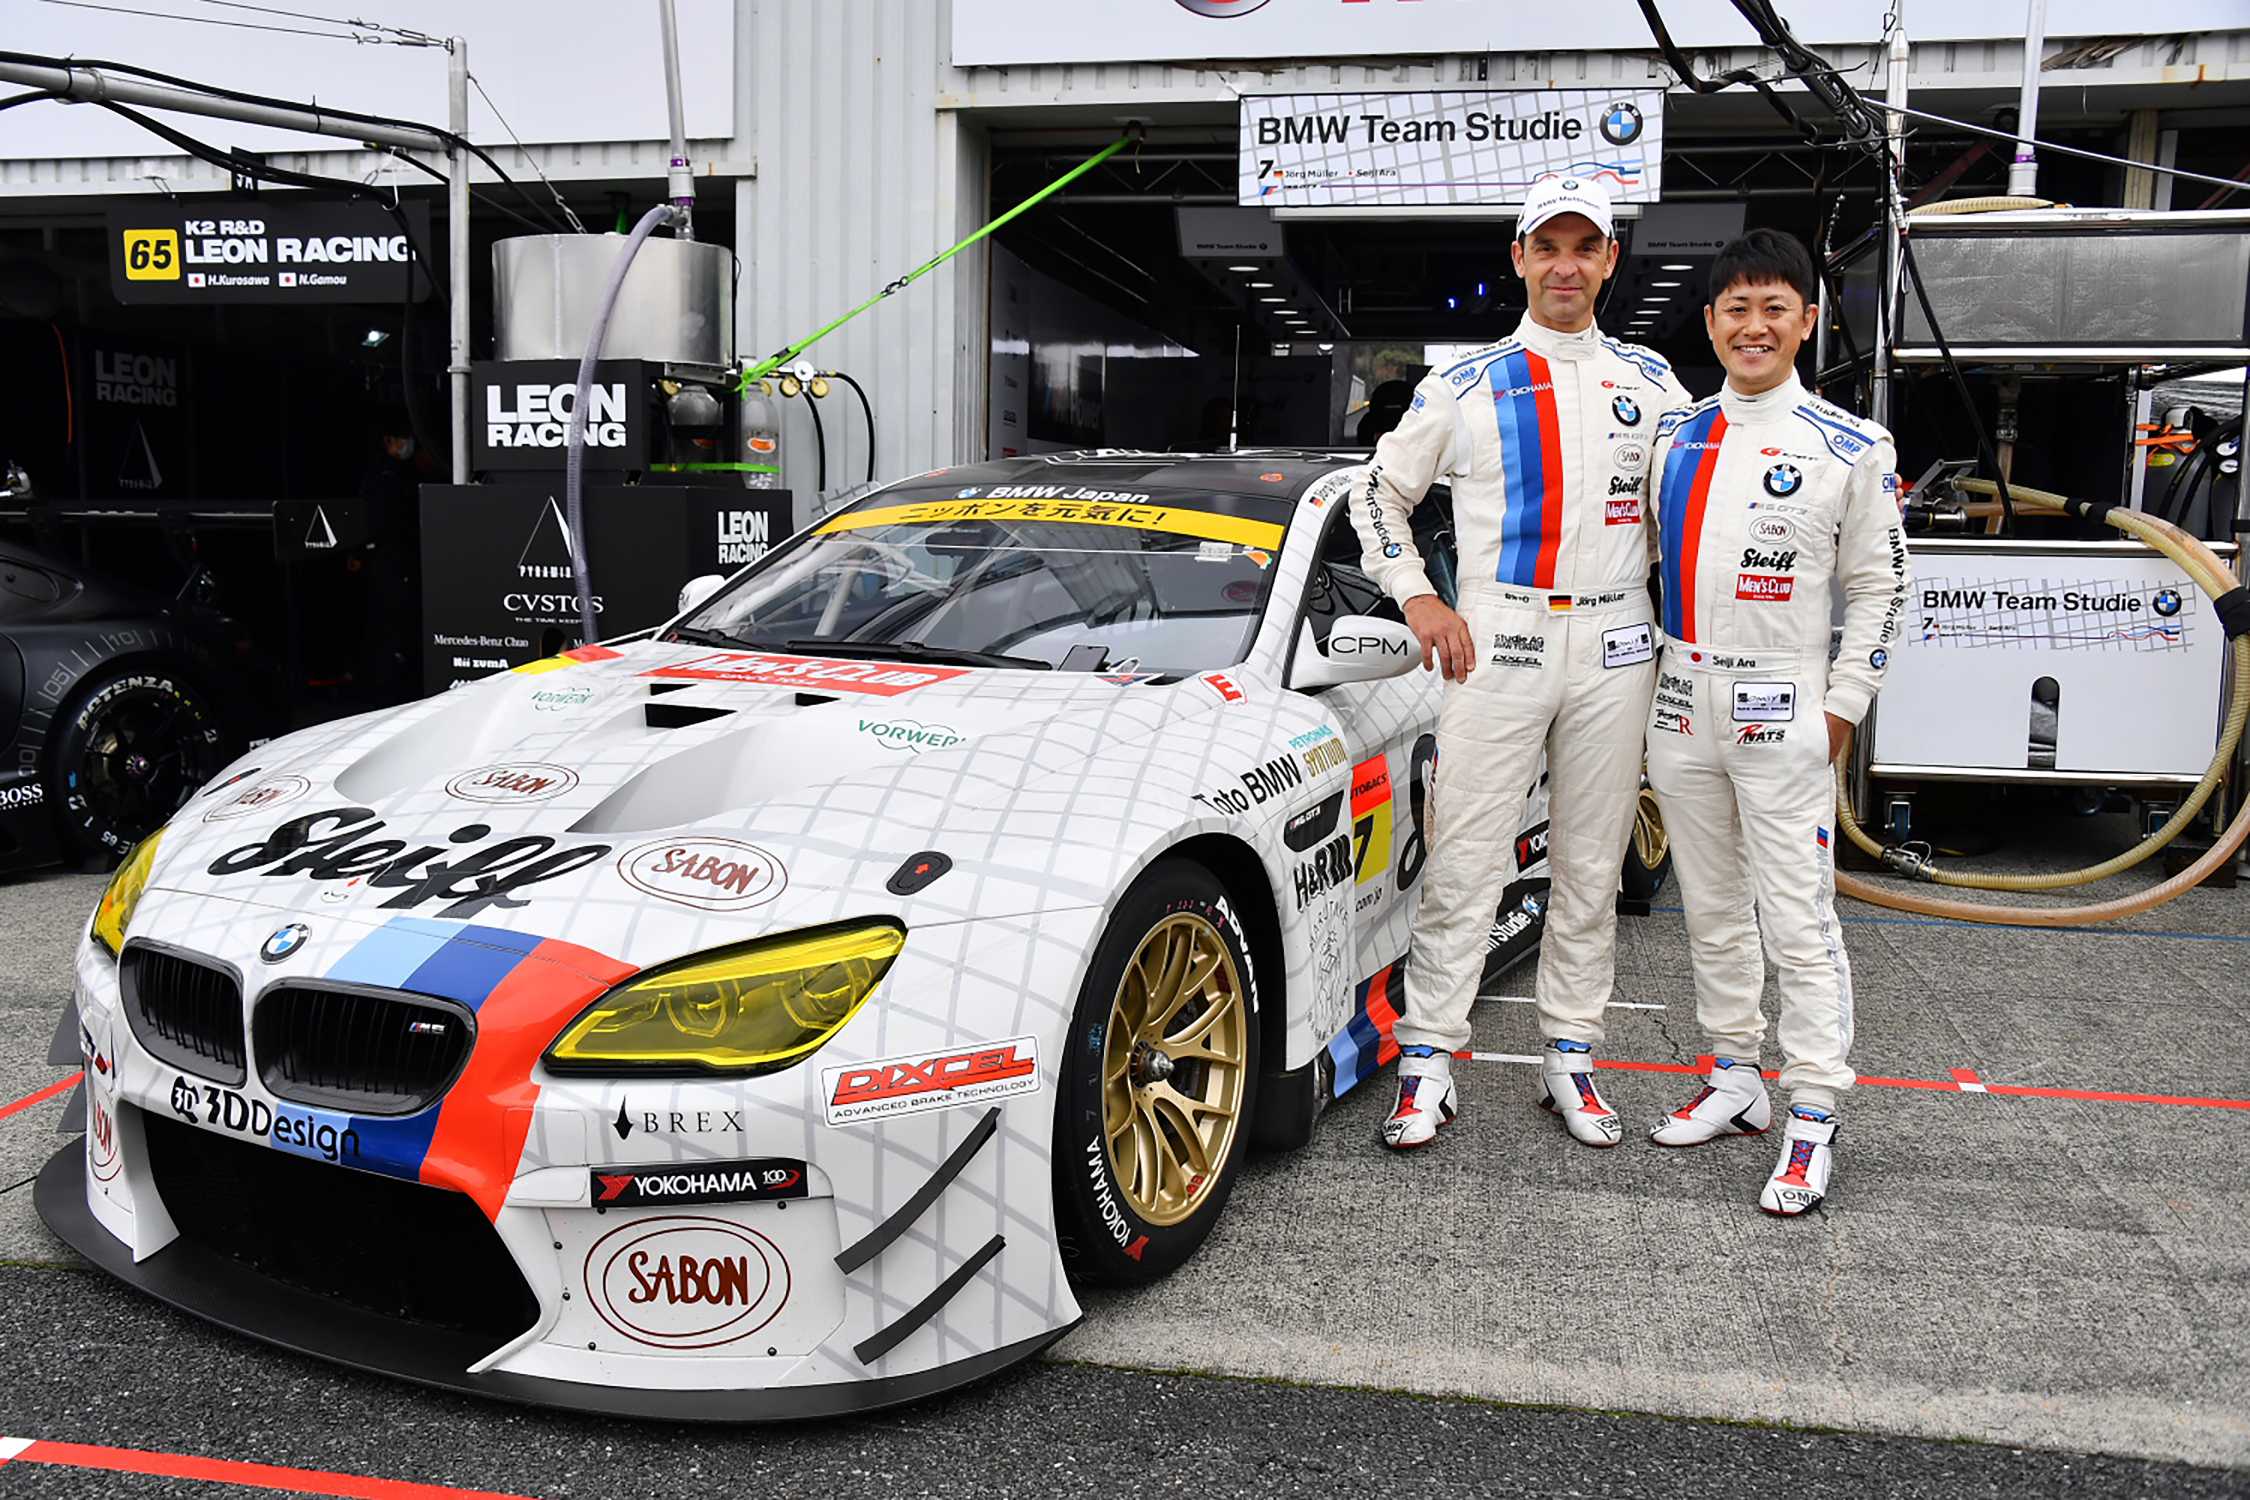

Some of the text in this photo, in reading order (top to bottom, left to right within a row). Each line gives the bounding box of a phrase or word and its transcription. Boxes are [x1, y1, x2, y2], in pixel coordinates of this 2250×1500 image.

[1258, 112, 1582, 145] BMW Team Studie
[1258, 160, 1275, 180] 7
[185, 219, 265, 236] K2 R&D
[130, 239, 172, 270] 65
[185, 236, 416, 264] LEON RACING
[96, 349, 176, 387] LEON
[96, 382, 177, 407] RACING
[487, 384, 626, 423] LEON
[487, 422, 626, 447] RACING
[1833, 434, 1861, 453] OMP
[986, 487, 1150, 505] BMW Japan
[718, 511, 768, 543] LEON
[718, 542, 769, 564] RACING
[1740, 548, 1798, 572] Steiff
[1923, 590, 2141, 612] BMW Team Studie
[434, 634, 502, 647] Mercedes-Benz
[1331, 636, 1408, 657] CPM
[1712, 656, 1756, 669] Seiji Ara
[76, 675, 174, 731] POTENZA
[1191, 753, 1303, 816] Toto BMW
[1351, 771, 1388, 800] TOBACS
[1354, 814, 1375, 883] 7
[206, 807, 613, 920] Steiff
[651, 848, 760, 895] SABON
[1215, 895, 1259, 1014] ADVAN
[831, 1045, 1034, 1106] DIXCEL
[835, 1079, 1034, 1119] ADVANCED BRAKE TECHNOLOGY
[643, 1111, 744, 1133] BREX
[634, 1172, 758, 1196] YOKOHAMA
[1086, 1135, 1132, 1250] YOKOHAMA
[628, 1250, 749, 1306] SABON
